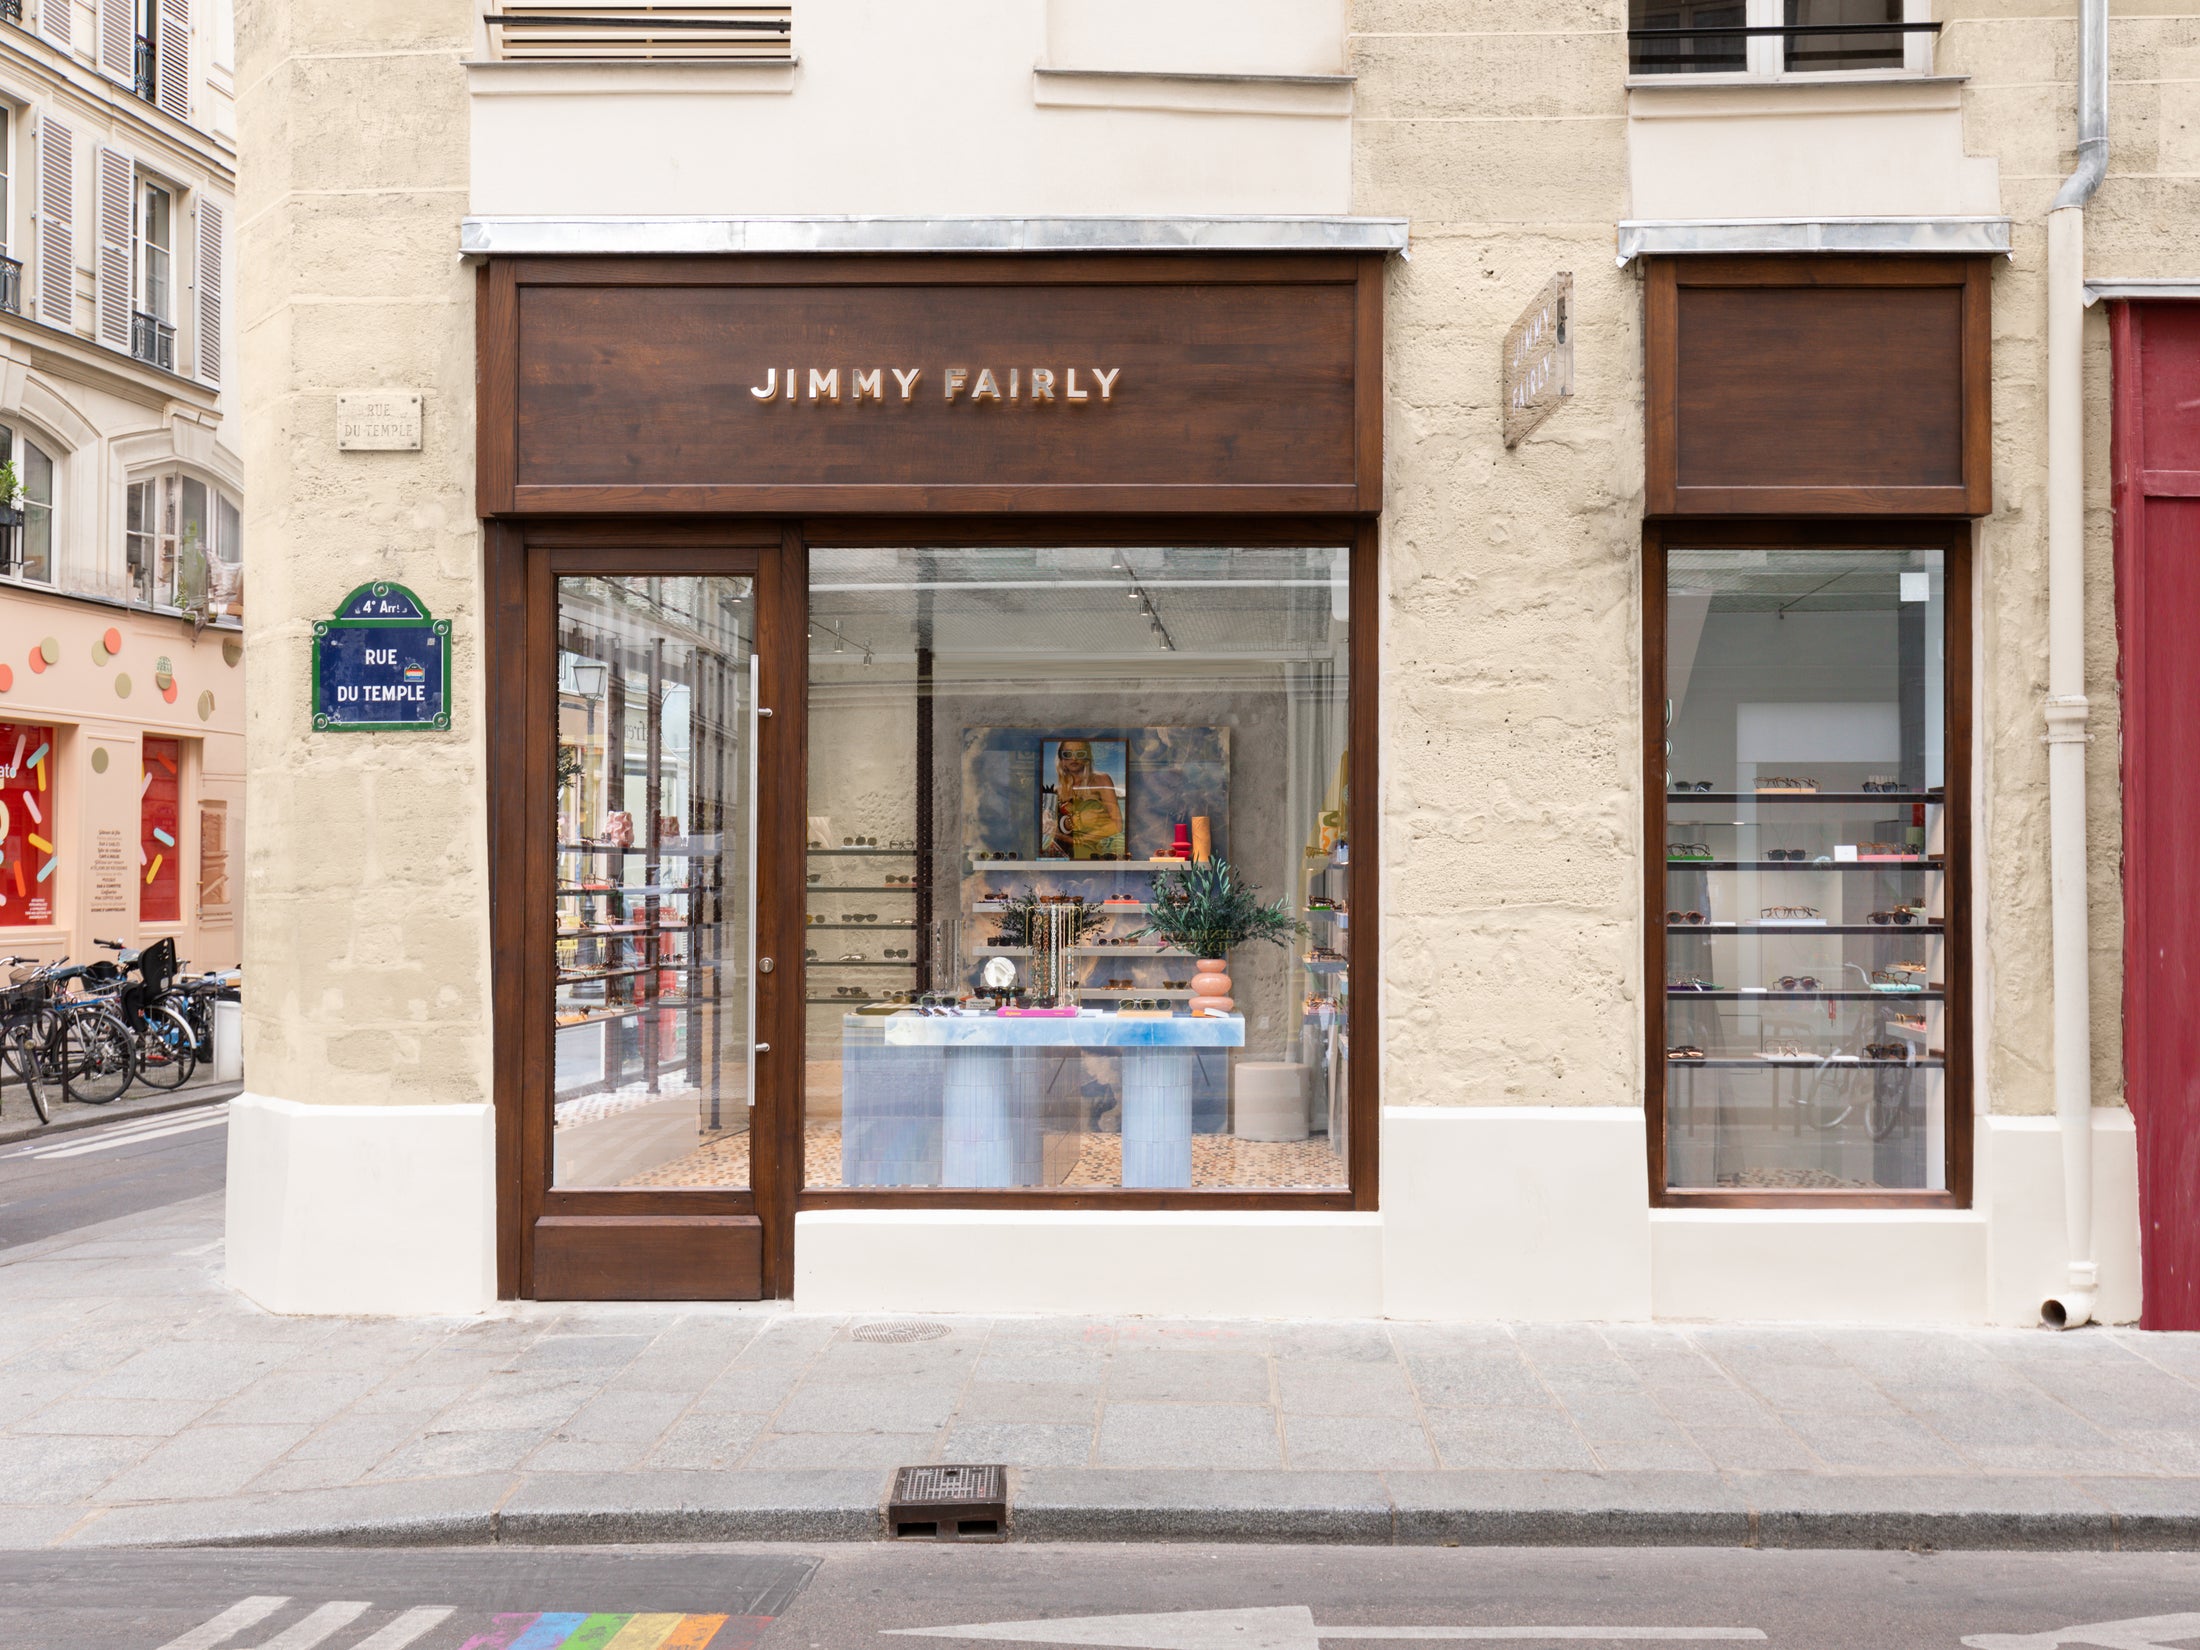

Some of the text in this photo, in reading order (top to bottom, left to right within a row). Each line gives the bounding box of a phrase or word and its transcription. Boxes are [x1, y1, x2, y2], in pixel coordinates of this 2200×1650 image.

[1513, 303, 1552, 368] JIMMY
[750, 368, 1121, 399] JIMMY FAIRLY
[1512, 351, 1551, 416] FAIRLY
[367, 403, 391, 417] RUE
[344, 424, 413, 437] DU TEMPLE
[365, 649, 398, 665] RUE
[337, 685, 426, 702] DU TEMPLE
